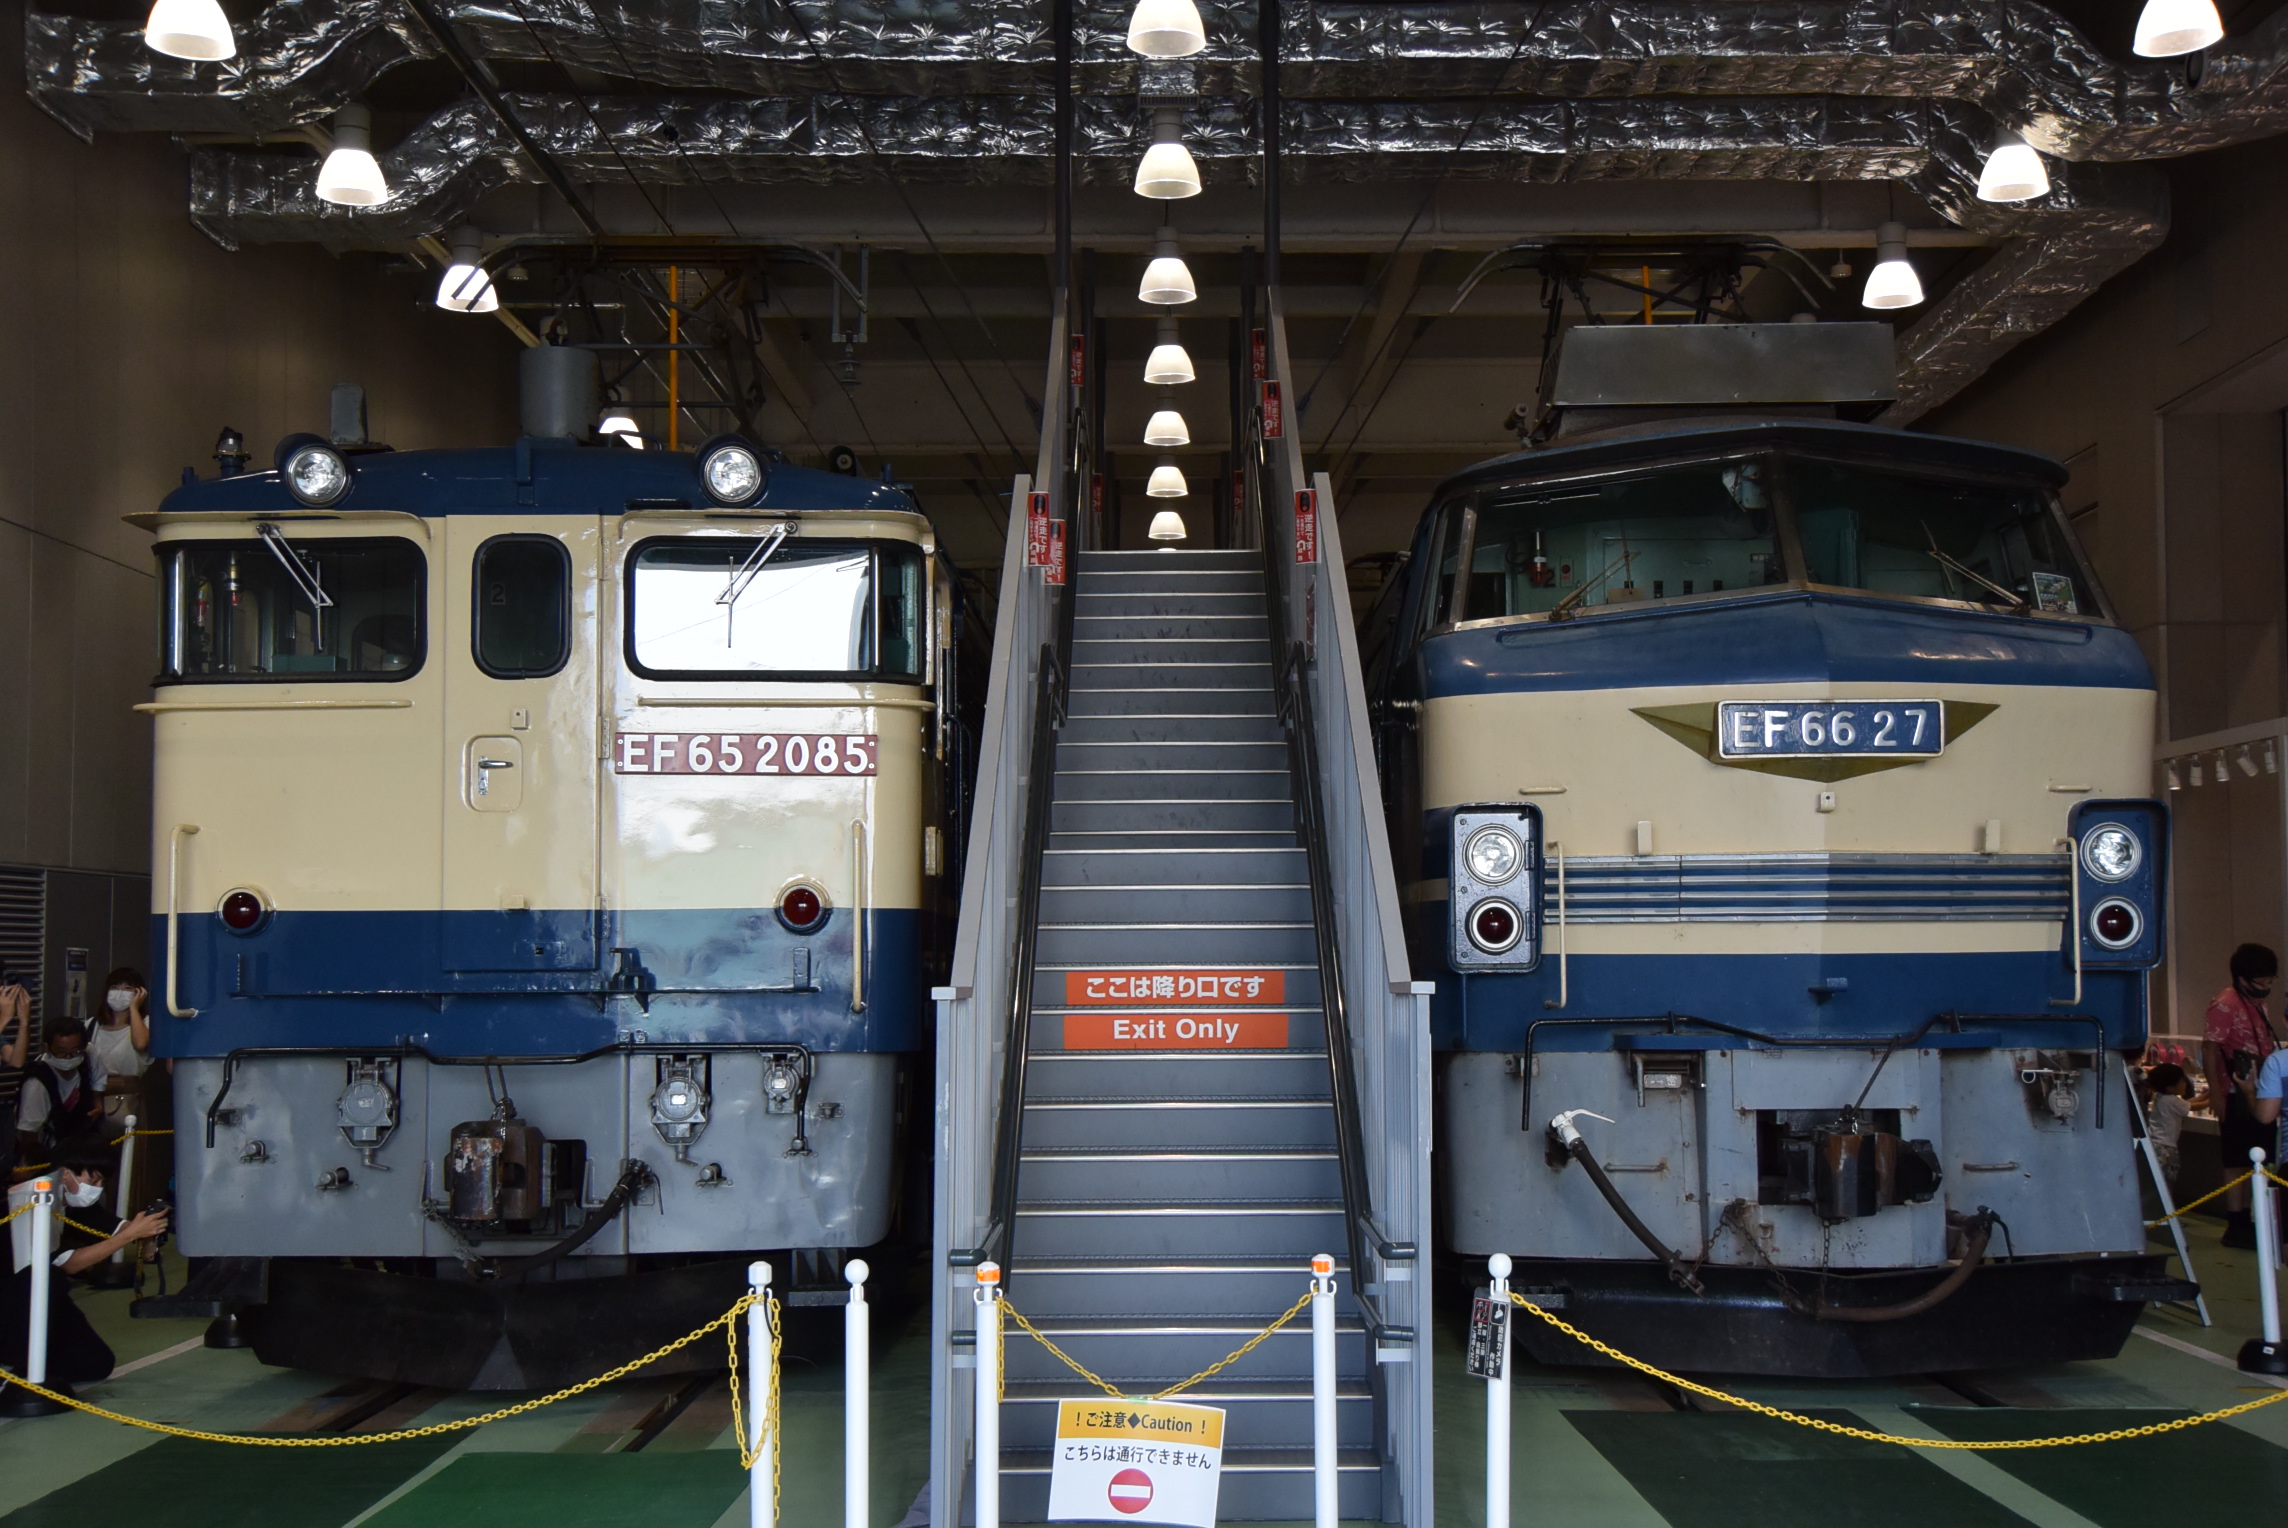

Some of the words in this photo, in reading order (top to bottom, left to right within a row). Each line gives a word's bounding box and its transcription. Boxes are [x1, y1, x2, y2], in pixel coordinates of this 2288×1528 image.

[492, 583, 504, 603] 2
[1873, 709, 1927, 747] 27
[755, 735, 868, 774] 2085
[1086, 976, 1265, 999] ここは降り口です
[1113, 1018, 1166, 1040] Exit
[1175, 1018, 1239, 1043] Only
[1064, 1445, 1211, 1470] こちらは通行できません
